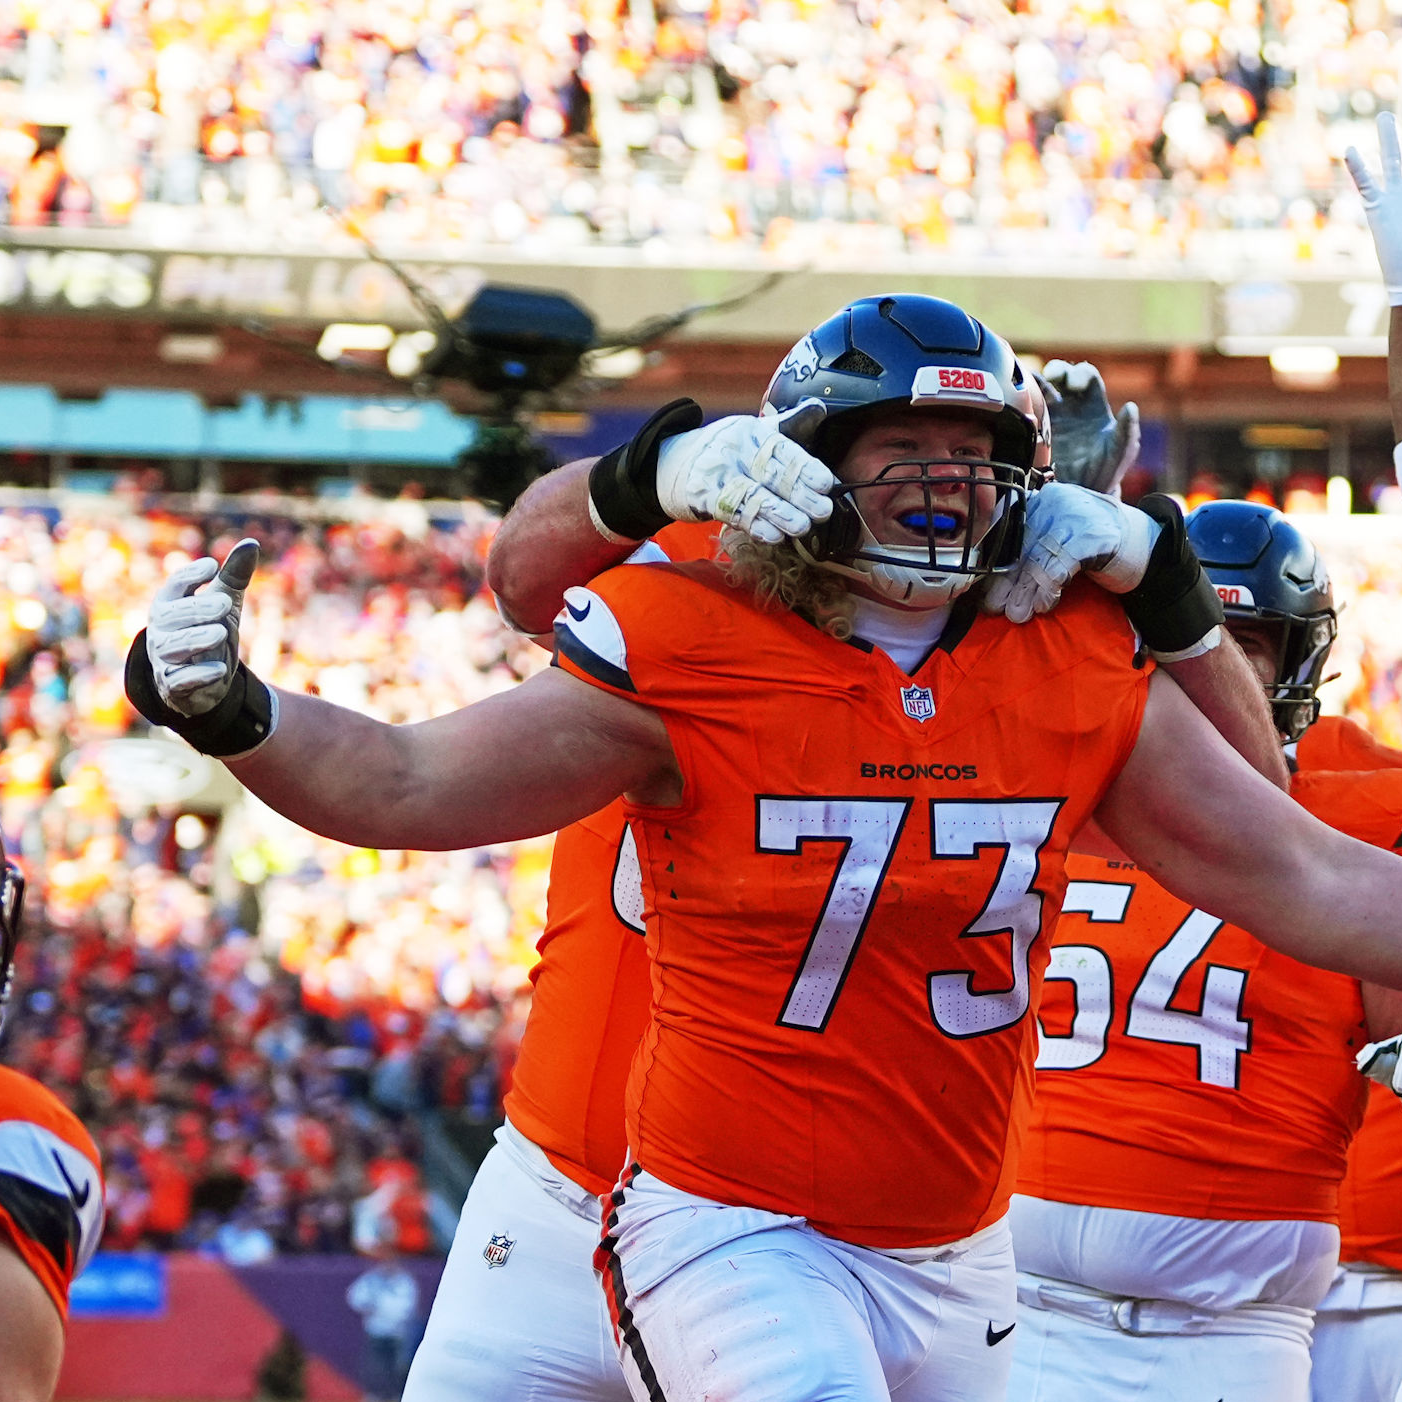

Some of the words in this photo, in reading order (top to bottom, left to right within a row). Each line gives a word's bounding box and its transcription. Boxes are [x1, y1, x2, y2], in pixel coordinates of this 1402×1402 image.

[939, 369, 985, 390] 5280
[909, 700, 930, 715] NFL
[861, 762, 978, 780] BRONCOS
[754, 794, 1067, 1039] 73
